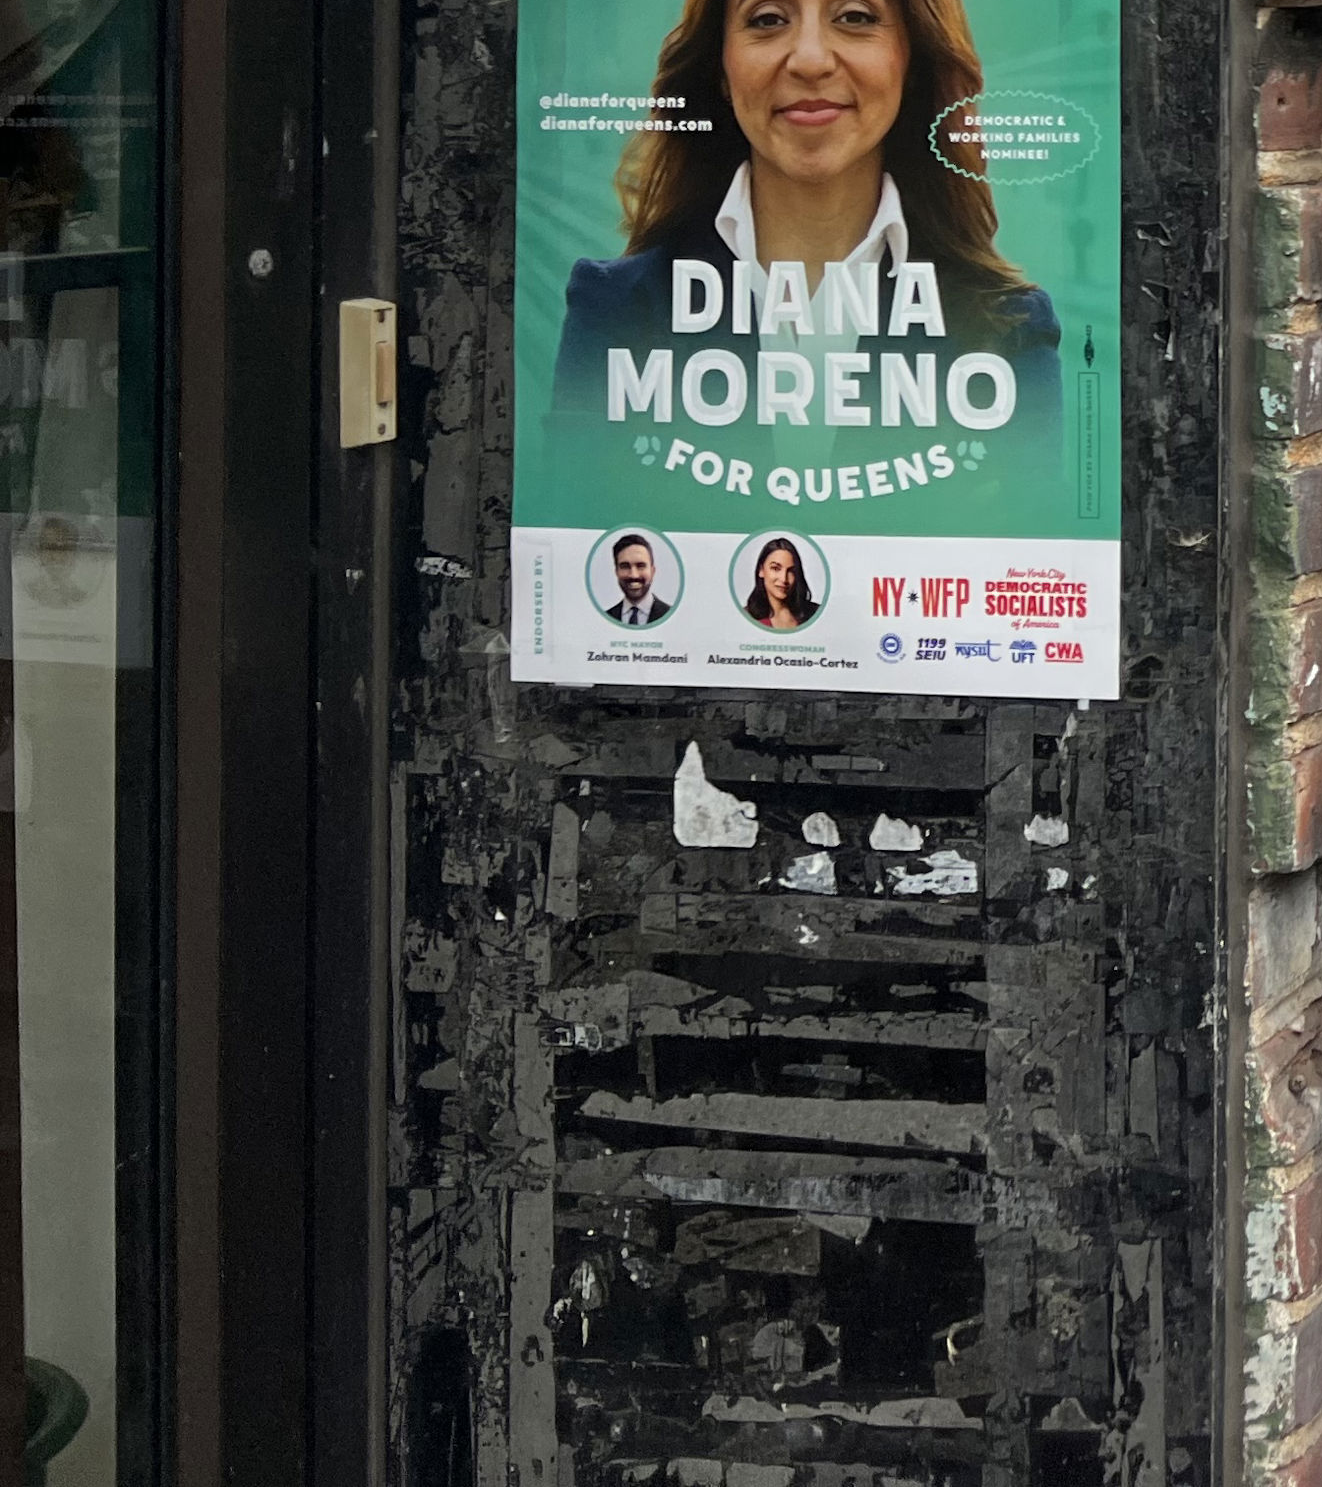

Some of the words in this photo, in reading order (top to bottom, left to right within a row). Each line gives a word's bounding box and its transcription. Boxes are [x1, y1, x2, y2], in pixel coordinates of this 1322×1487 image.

[539, 92, 687, 112] @dianaforqueens
[540, 115, 714, 135] dianaforqueens.com
[963, 115, 1055, 127] DEMOCRATIC
[1056, 115, 1067, 127] &
[948, 131, 1015, 143] WORKING
[1017, 131, 1081, 143] FAMILIES
[980, 148, 1049, 160] NOMINEE!
[670, 258, 946, 338] DIANA
[606, 347, 1018, 431] MORENO
[663, 436, 754, 497] FOR
[765, 442, 956, 507] QUEENS
[1006, 567, 1026, 579] New
[984, 580, 1087, 595] DEMOCRATIC
[872, 576, 907, 618] NY
[920, 577, 971, 618] WFP
[984, 594, 1088, 618] SOCIALISTS
[533, 580, 544, 655] ENDORSED
[1010, 619, 1022, 630] of
[1022, 619, 1061, 629] America
[738, 644, 826, 654] CONGRESSWOMAN
[917, 637, 947, 649] 1199
[1044, 641, 1085, 660] CWA
[586, 651, 630, 663] Zohran
[632, 651, 689, 664] Mamdani
[707, 653, 771, 667] Alexandria
[773, 655, 859, 670] Ocasio-Cortez
[914, 649, 947, 661] SEIU
[1011, 651, 1036, 664] UFT
